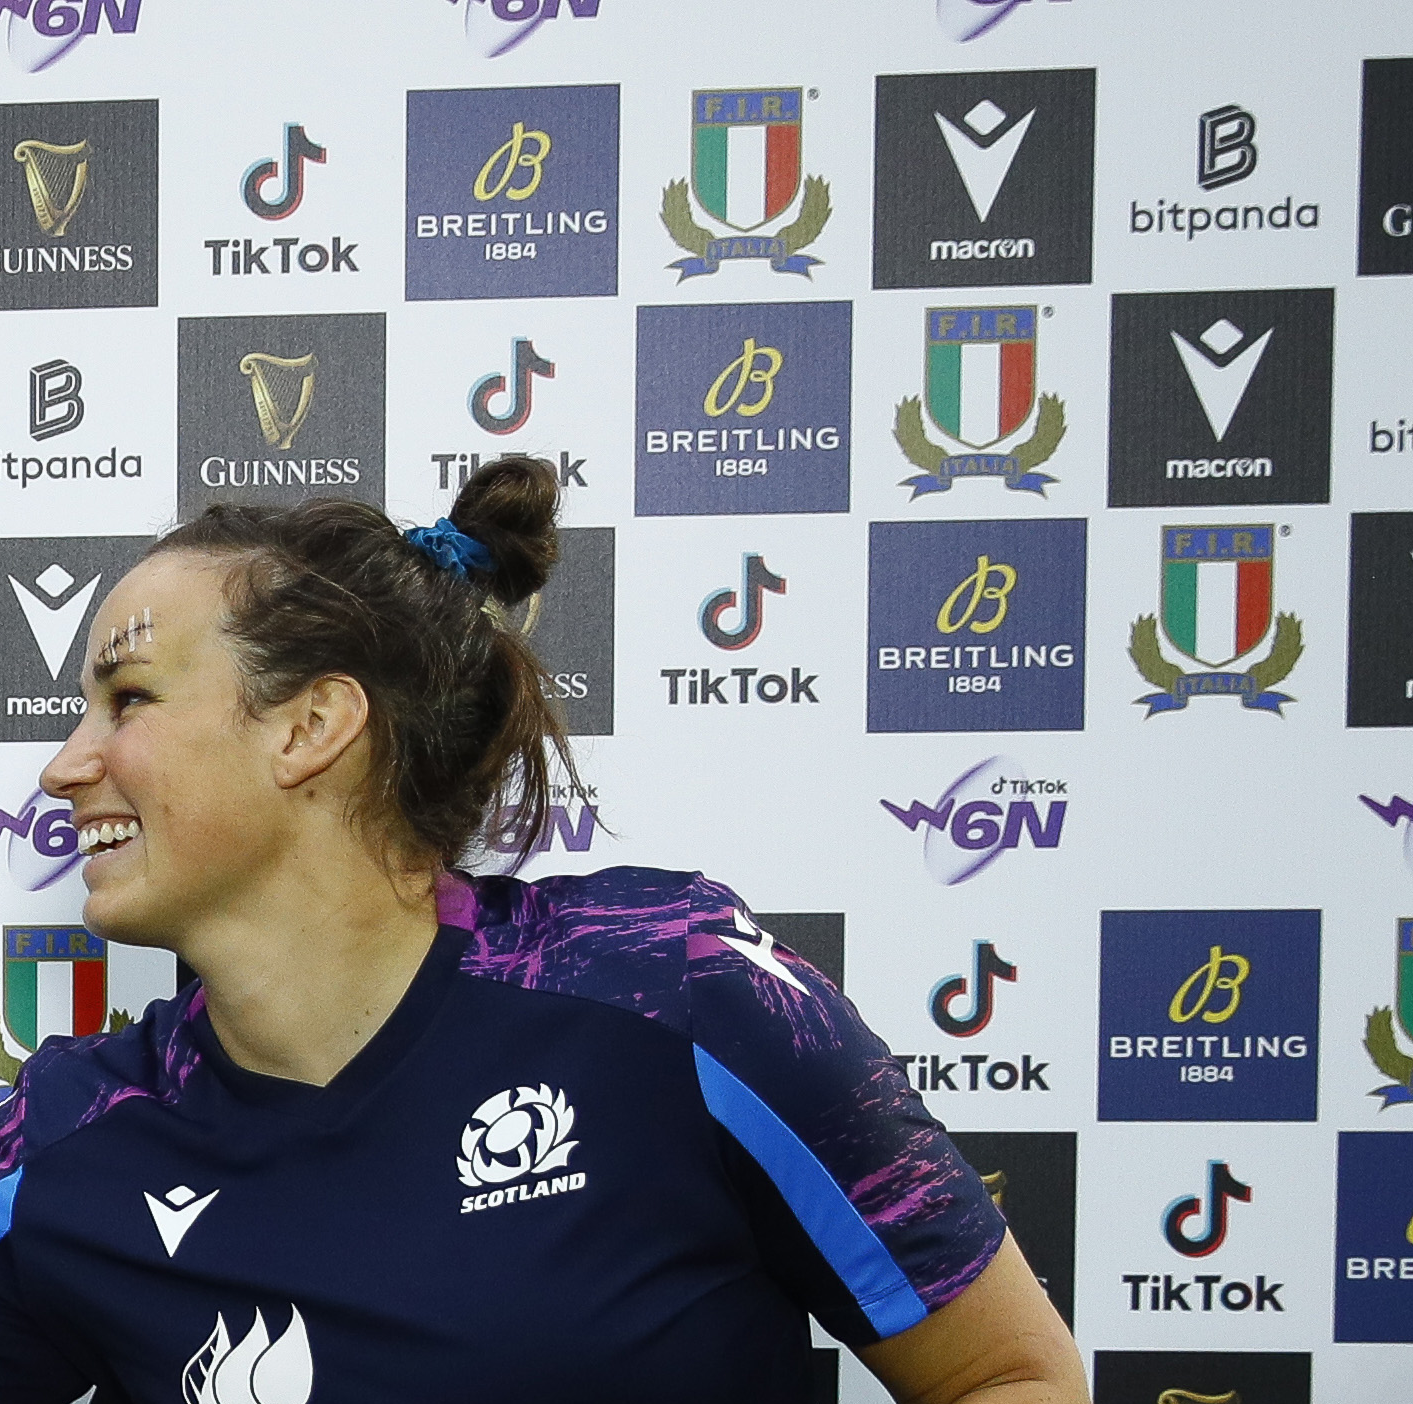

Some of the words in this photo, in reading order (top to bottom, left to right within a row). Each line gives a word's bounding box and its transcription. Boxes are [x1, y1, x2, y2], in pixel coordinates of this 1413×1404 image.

[704, 97, 794, 120] F.I.R.
[418, 211, 606, 237] BREITLING
[1131, 197, 1318, 240] bitpanda
[205, 237, 359, 275] TikTok
[486, 243, 536, 259] 1884
[931, 239, 1034, 260] macron
[937, 315, 1027, 338] F.I.R.
[647, 428, 838, 452] BREITLING
[201, 457, 359, 486] GUINNESS
[717, 459, 767, 476] 1884
[1167, 458, 1272, 478] macron
[1174, 534, 1267, 557] F.I.R.
[880, 645, 1073, 669] BREITLING
[661, 668, 819, 704] TikTok
[949, 676, 1001, 692] 1884
[7, 697, 87, 715] macro
[1011, 780, 1067, 795] TikTok
[15, 933, 100, 955] F.I.R.
[1111, 1036, 1306, 1057] BREITLING
[1181, 1066, 1233, 1082] 1884
[460, 1172, 587, 1214] SCOTLAND
[1123, 1275, 1283, 1311] TikTok
